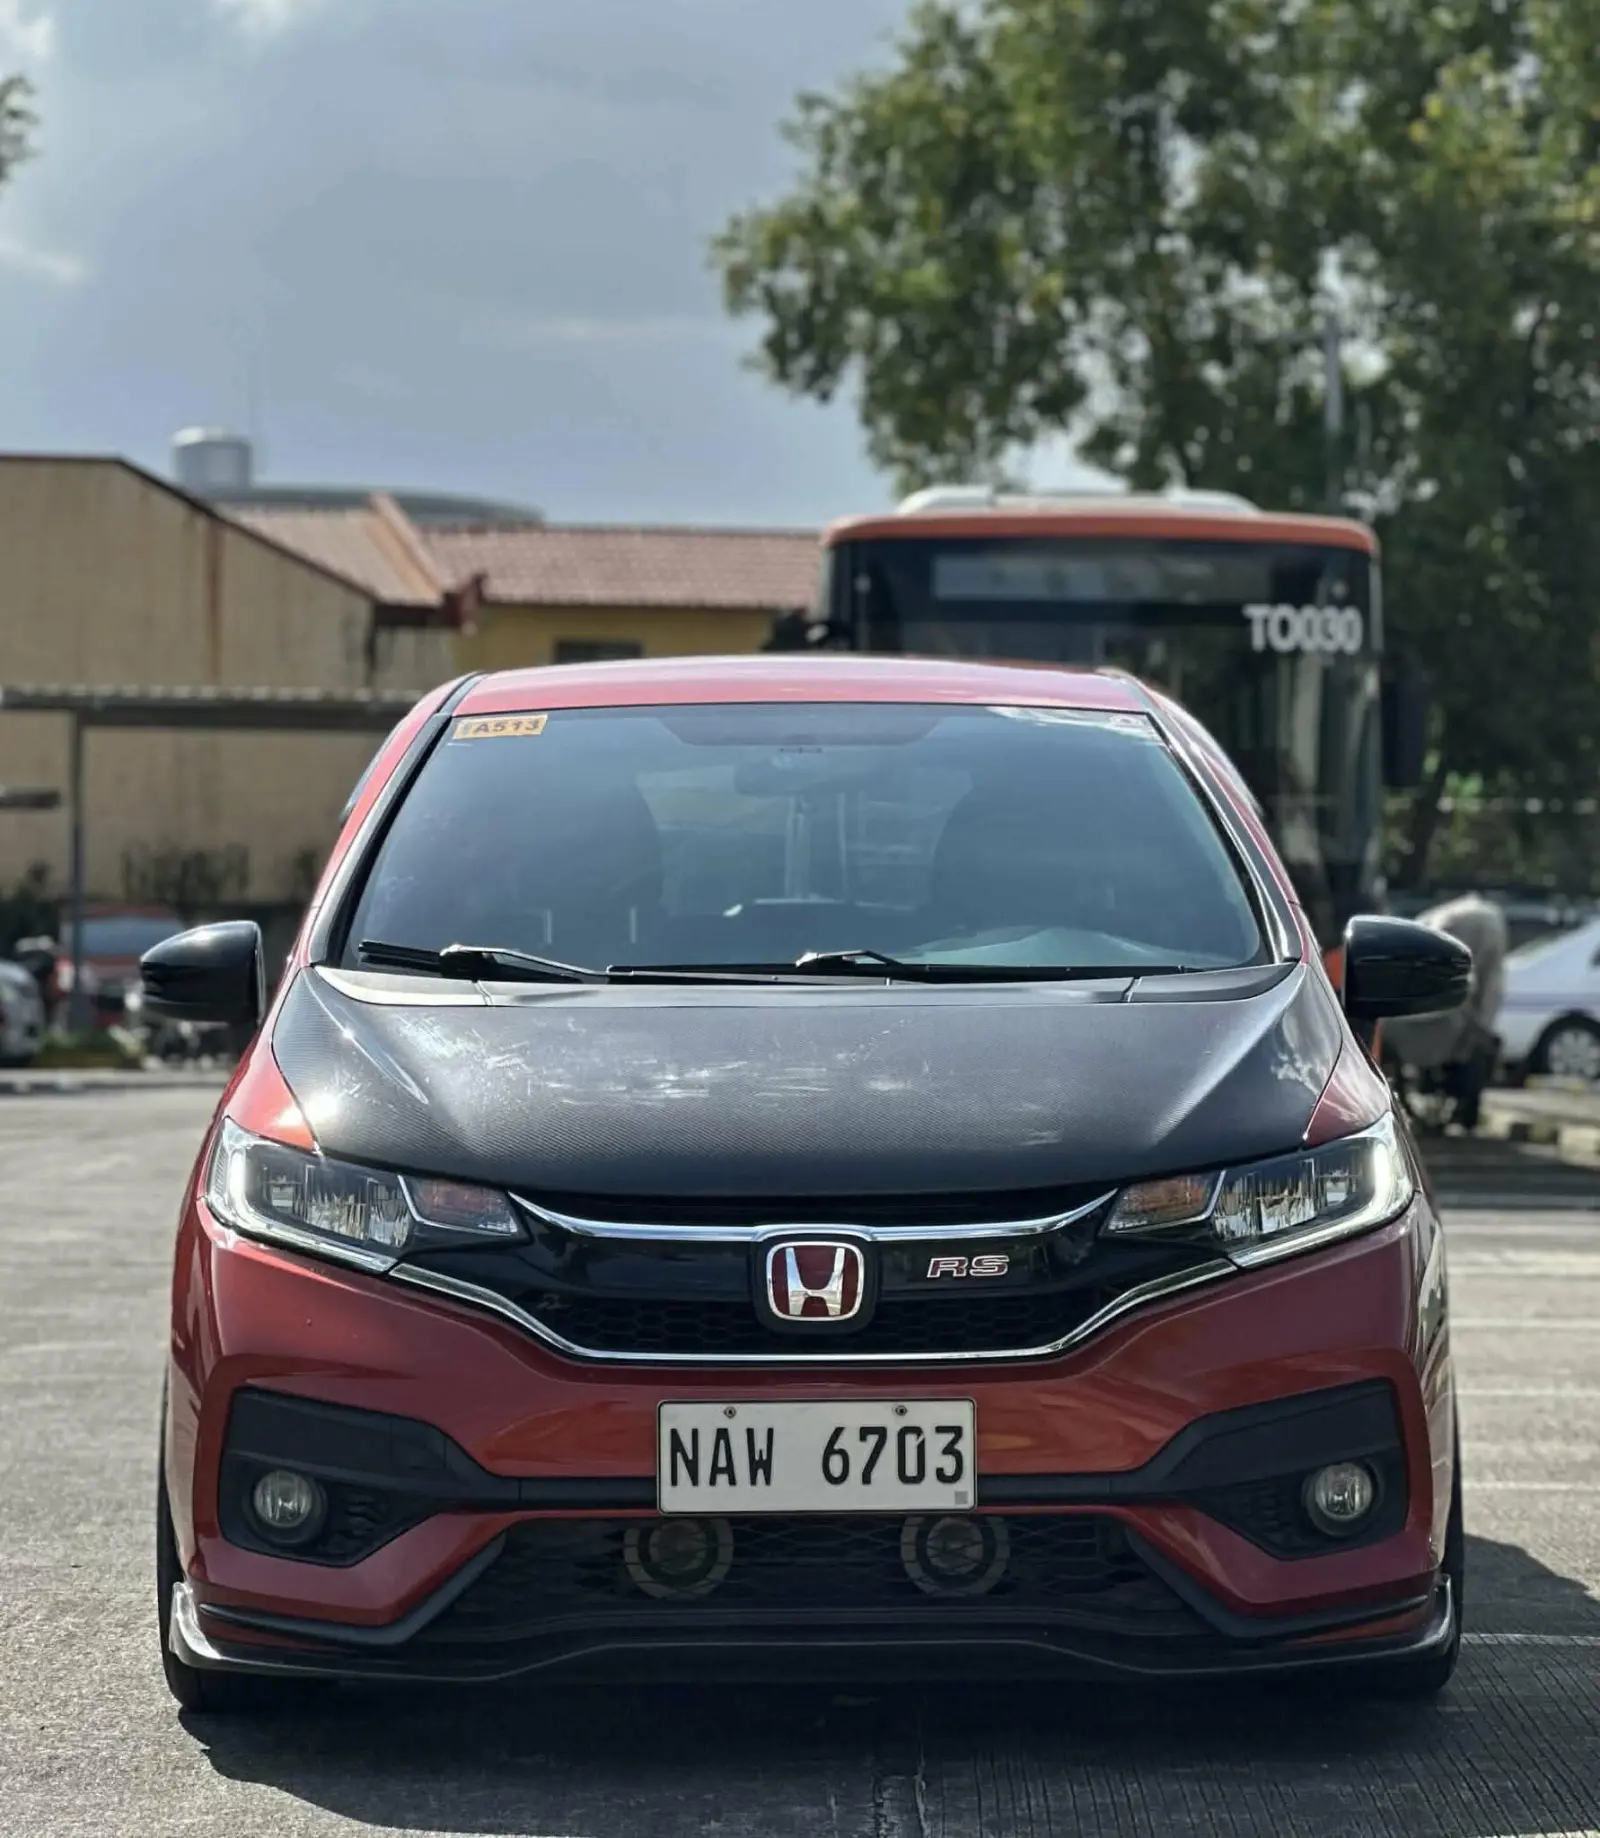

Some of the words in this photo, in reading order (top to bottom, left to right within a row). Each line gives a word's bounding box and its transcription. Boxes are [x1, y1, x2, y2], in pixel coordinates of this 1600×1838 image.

[926, 1254, 1009, 1278] RS
[669, 1427, 775, 1487] NAW
[821, 1425, 964, 1486] 6703
